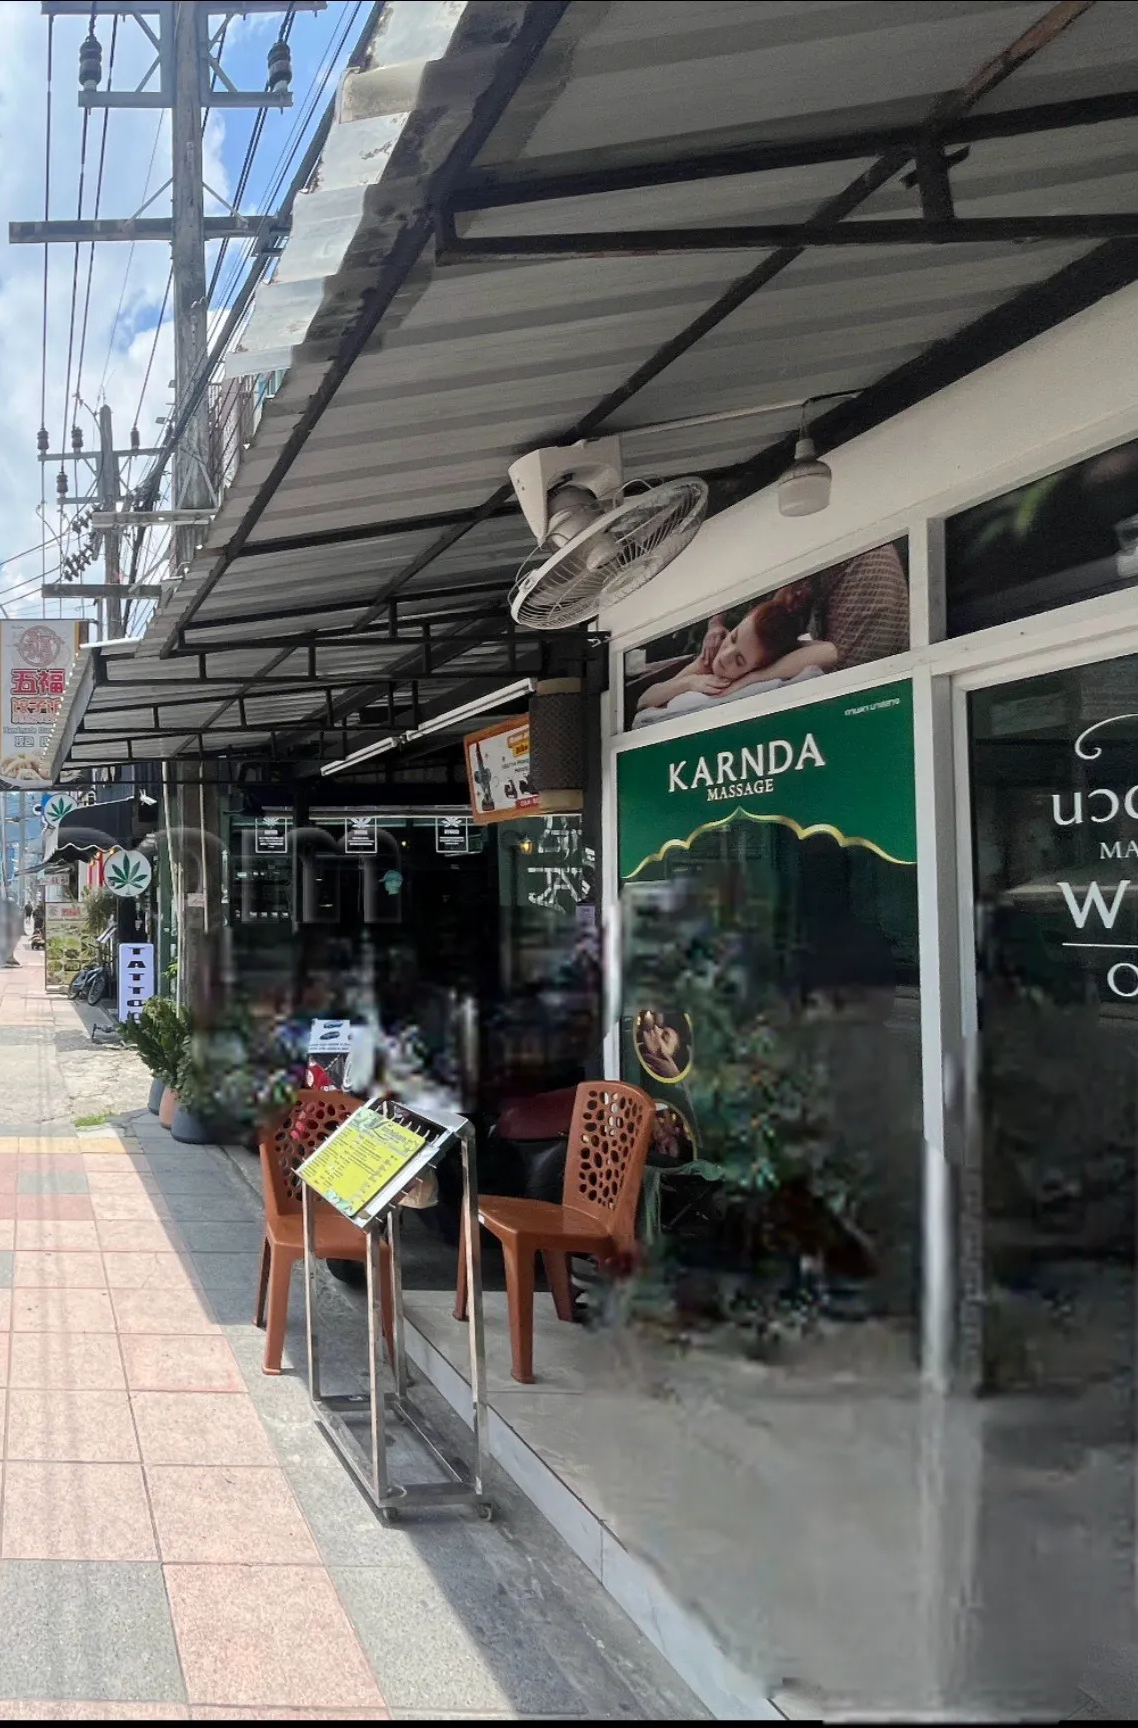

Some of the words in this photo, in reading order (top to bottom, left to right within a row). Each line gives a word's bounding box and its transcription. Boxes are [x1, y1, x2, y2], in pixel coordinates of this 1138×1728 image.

[11, 669, 66, 695] 五福
[668, 733, 826, 793] KARNDA
[706, 778, 774, 801] MASSAGE
